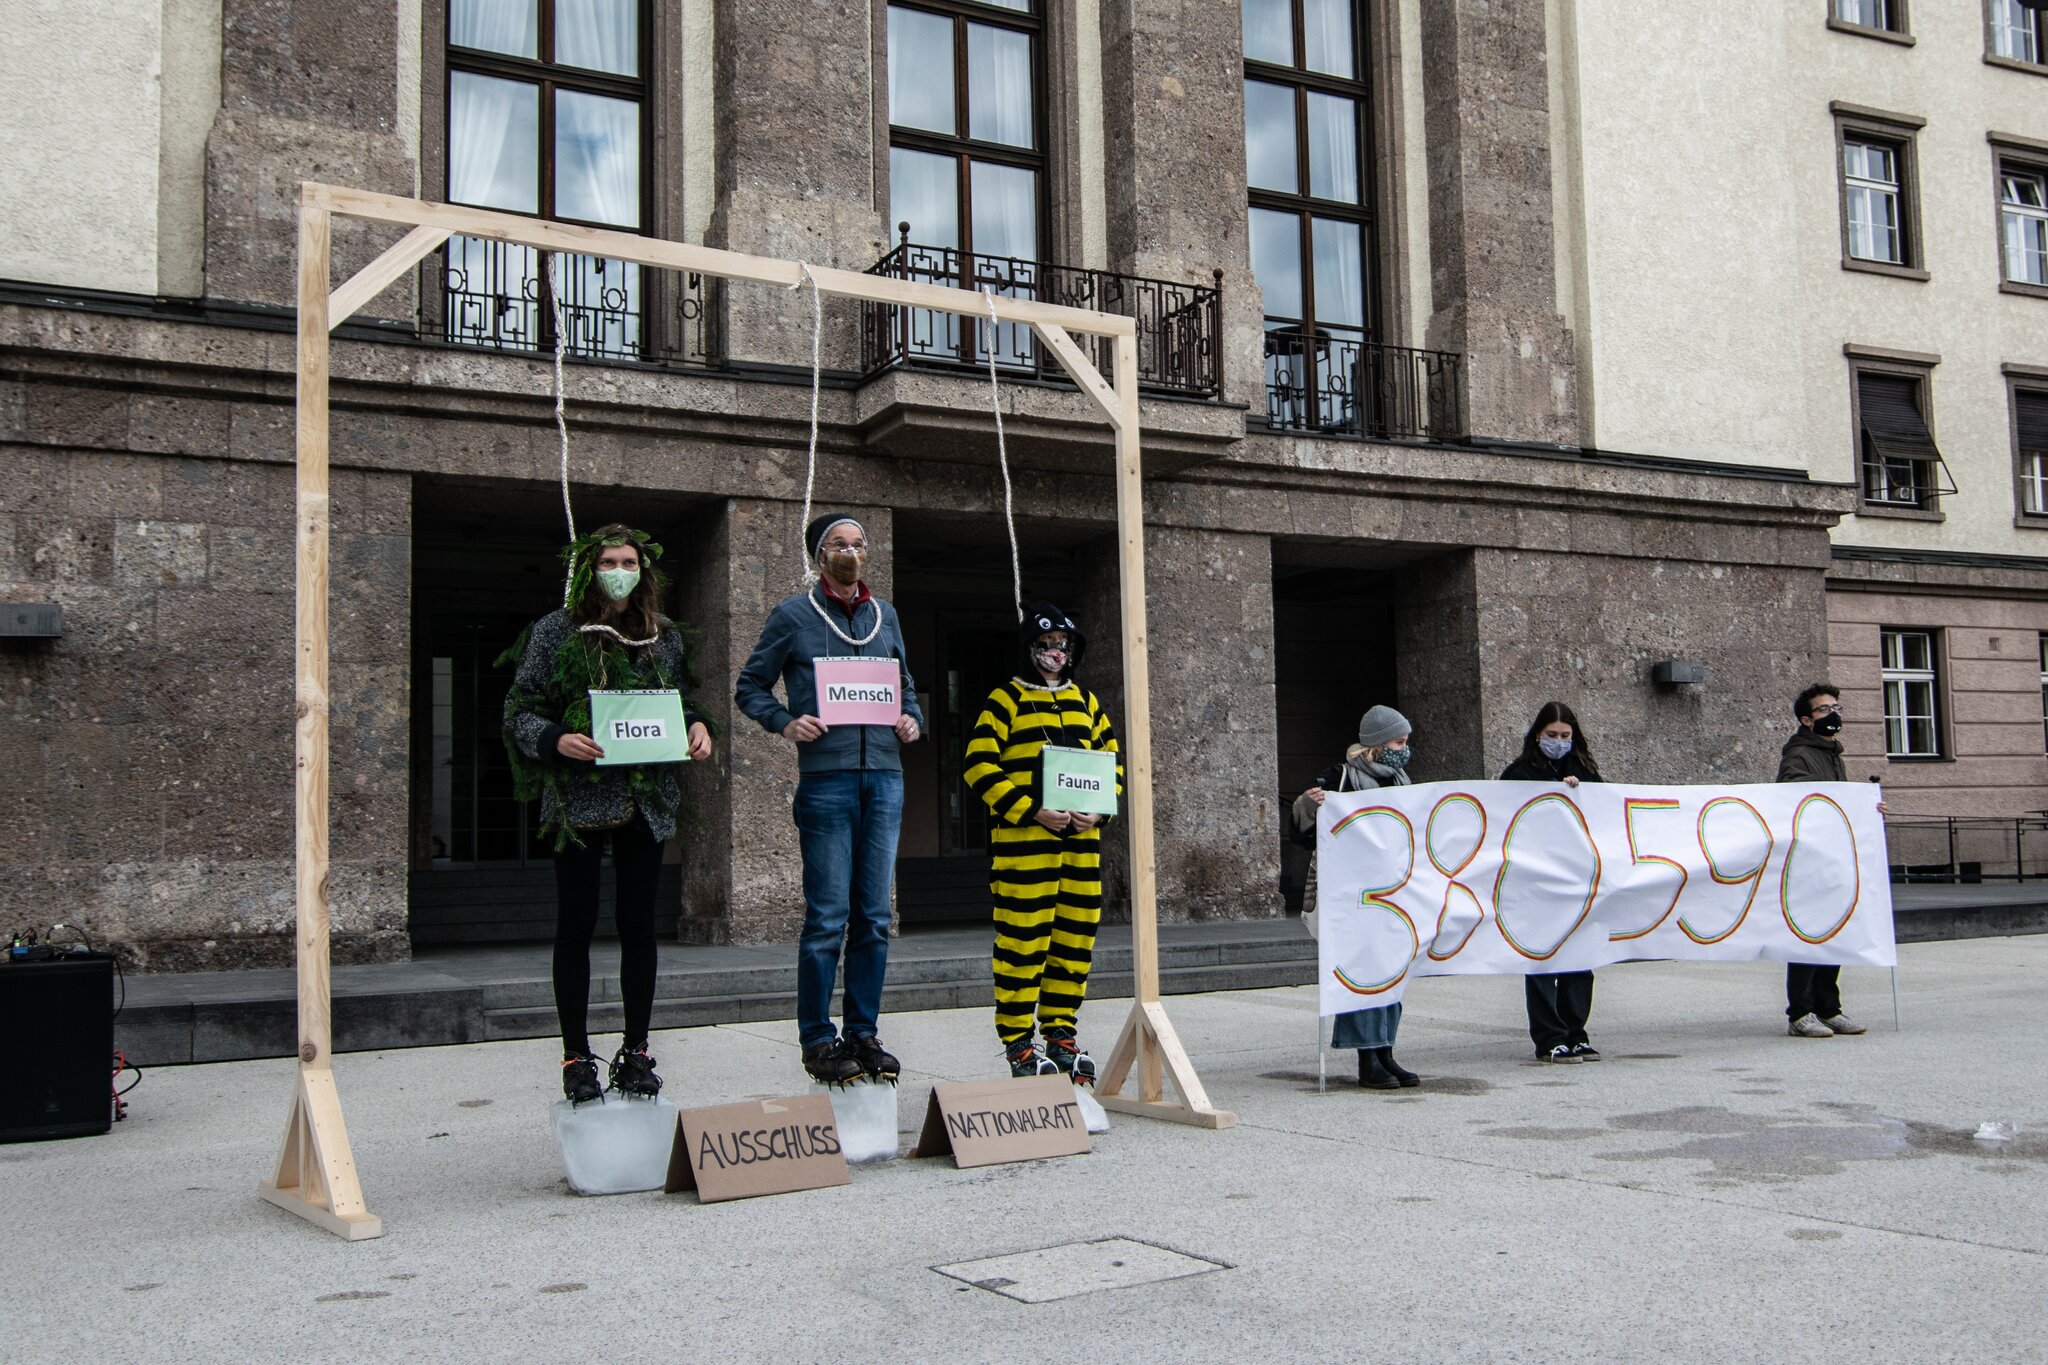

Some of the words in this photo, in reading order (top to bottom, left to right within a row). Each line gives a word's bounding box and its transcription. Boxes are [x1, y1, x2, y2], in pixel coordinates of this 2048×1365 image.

[829, 686, 893, 703] Mensch
[614, 721, 661, 738] Flora
[1057, 773, 1100, 791] Fauna
[947, 1101, 1078, 1139] NATIONALRAT
[699, 1125, 842, 1170] AUSSCHUSS
